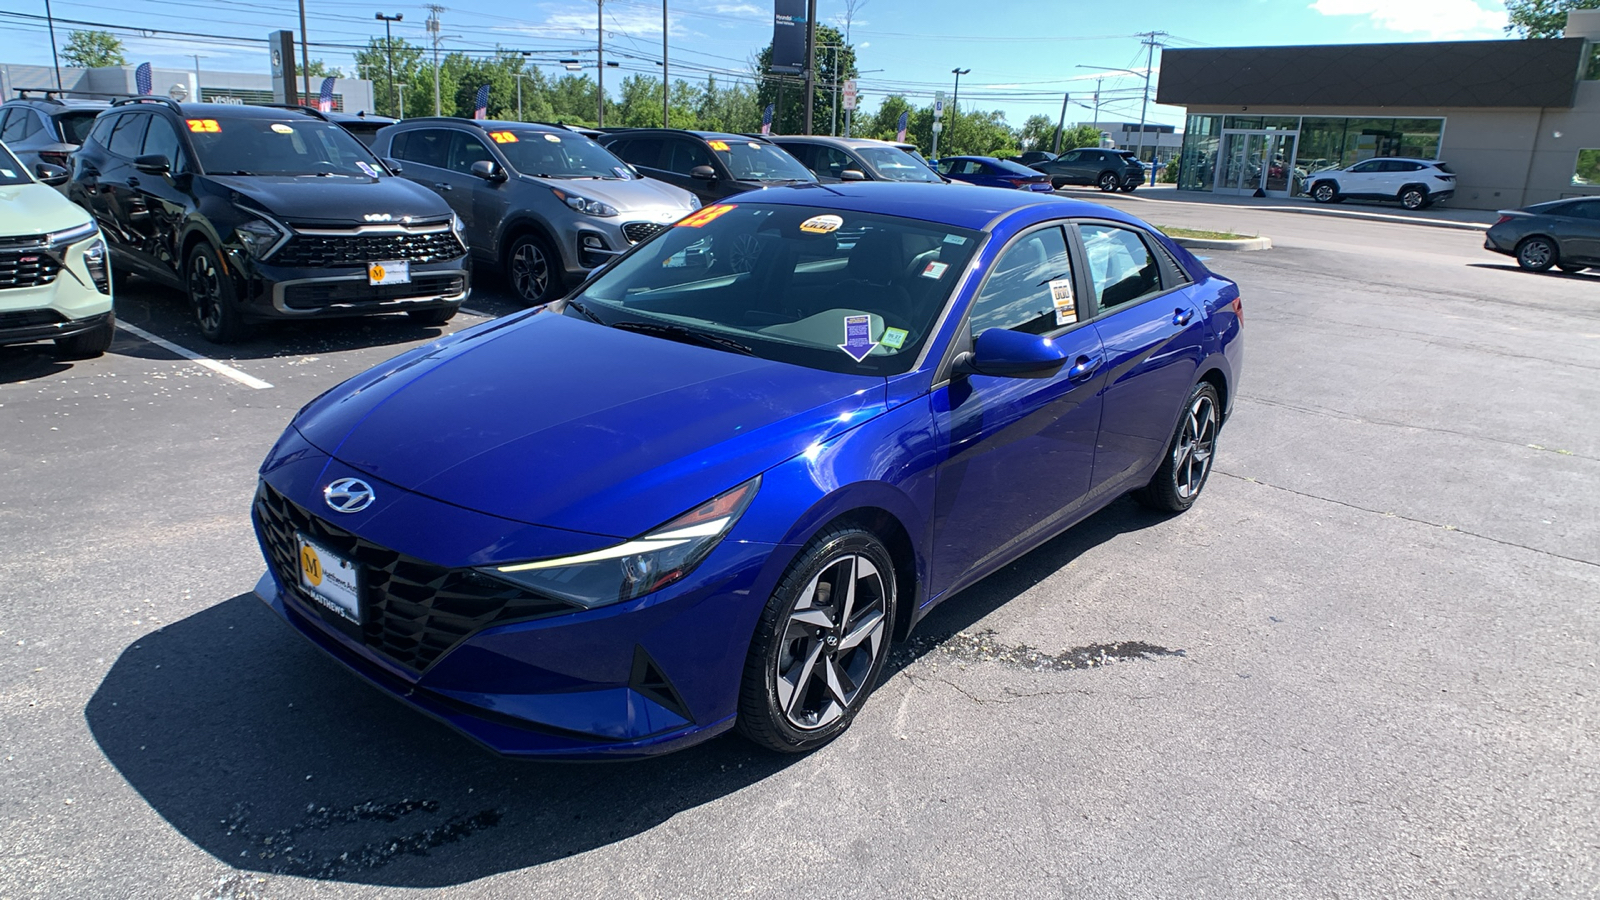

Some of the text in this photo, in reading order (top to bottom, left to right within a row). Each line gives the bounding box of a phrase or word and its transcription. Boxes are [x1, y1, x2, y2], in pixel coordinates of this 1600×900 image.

[210, 96, 243, 104] Vision
[188, 120, 218, 132] 23
[492, 132, 516, 143] 20
[677, 206, 734, 227] 23
[304, 552, 319, 577] M
[310, 590, 346, 617] MATTHEWS
